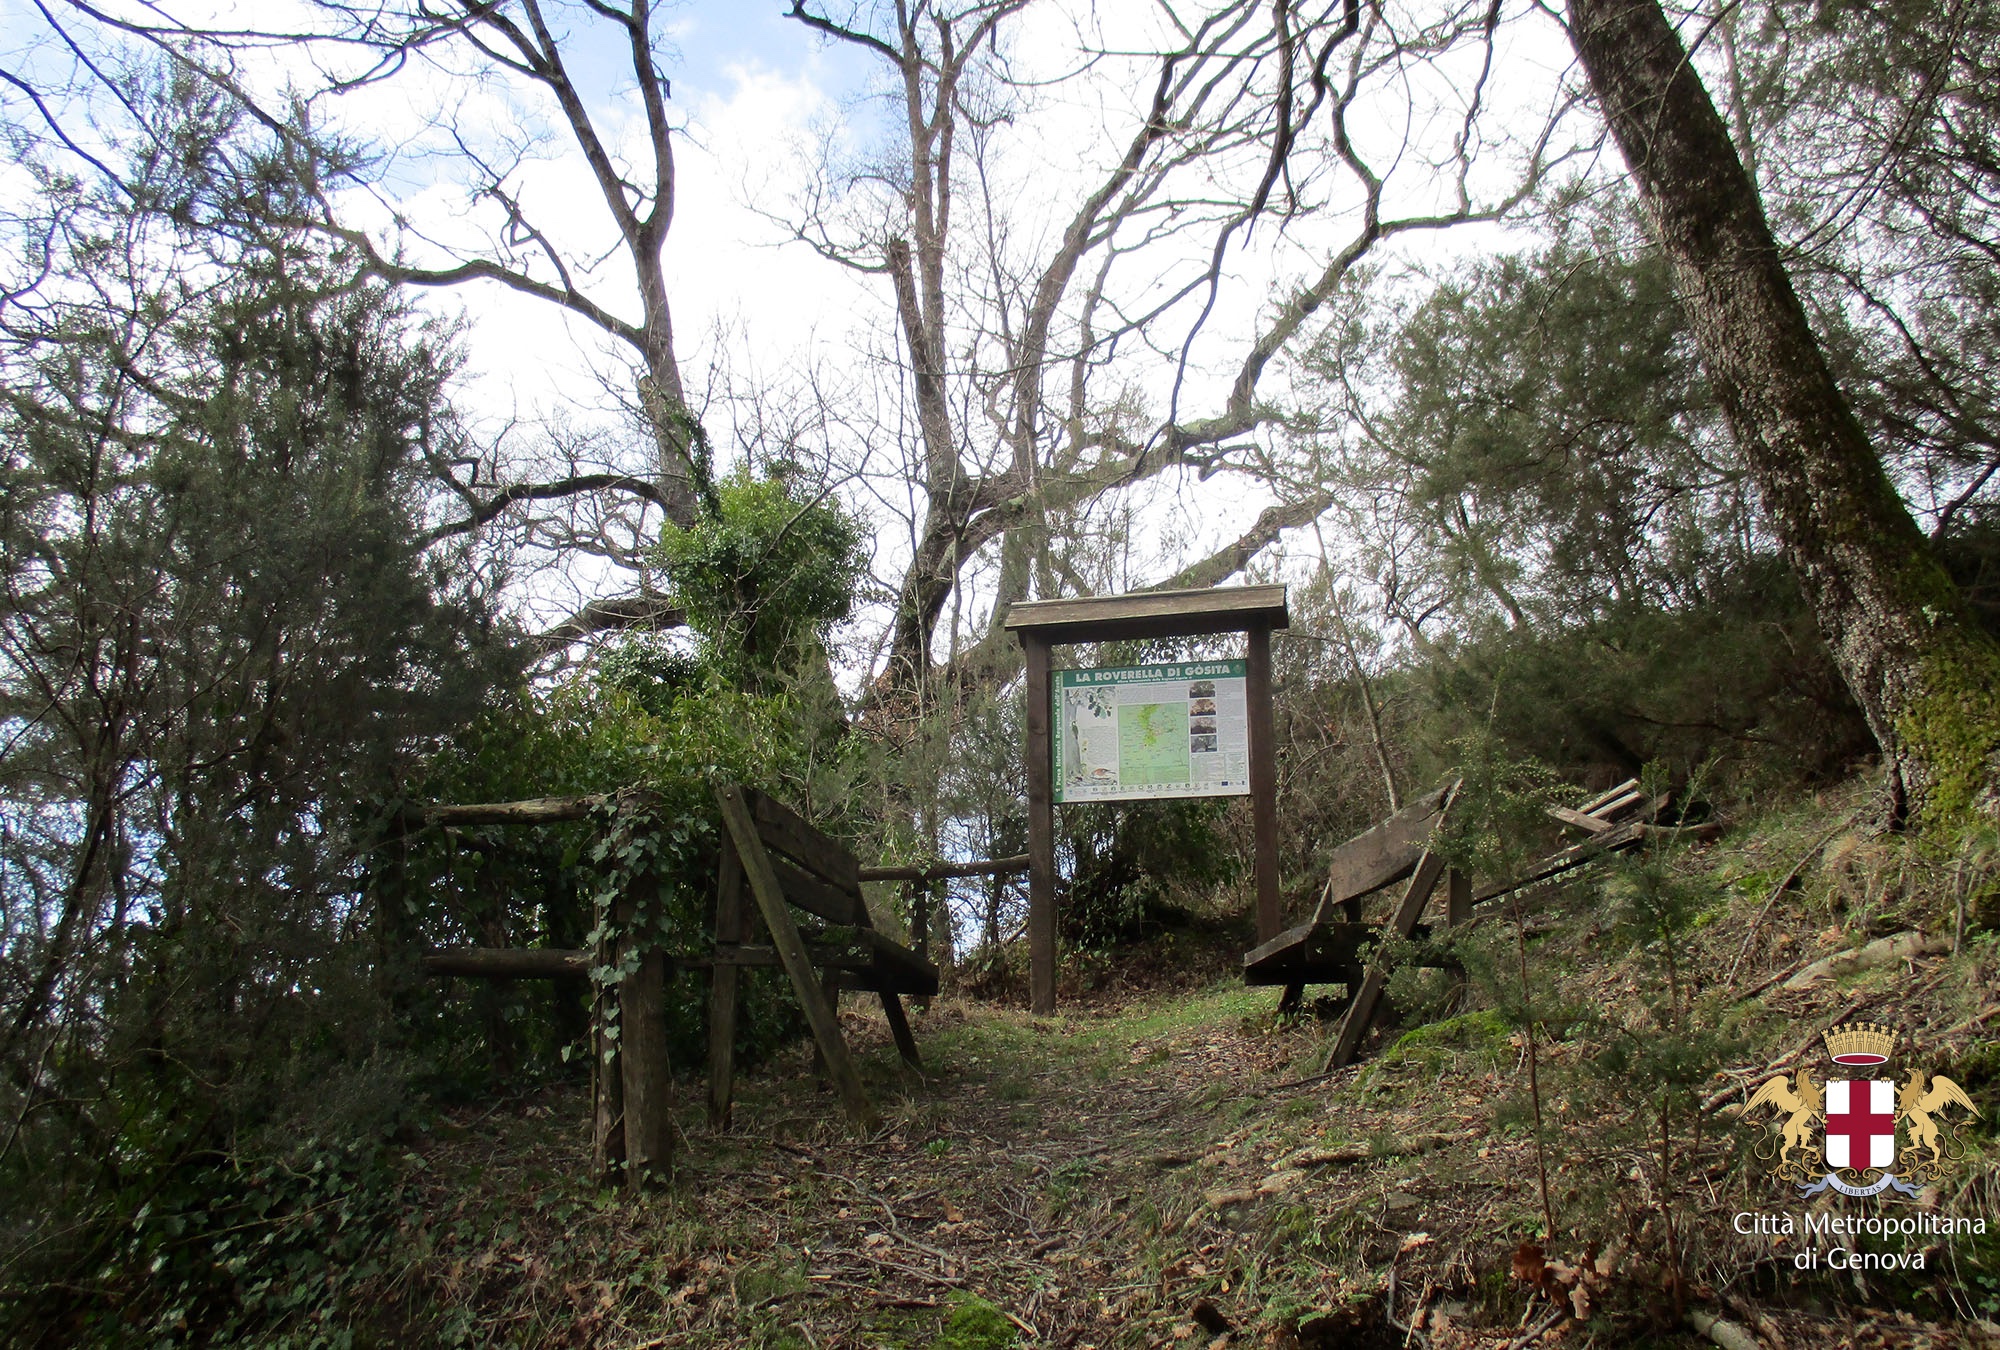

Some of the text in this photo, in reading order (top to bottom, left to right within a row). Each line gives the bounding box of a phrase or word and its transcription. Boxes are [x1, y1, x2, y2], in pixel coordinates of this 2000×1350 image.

[1075, 673, 1091, 683] LA
[1094, 668, 1163, 681] ROVERELLA
[1167, 667, 1181, 677] DI
[1184, 664, 1231, 676] GÒSITA
